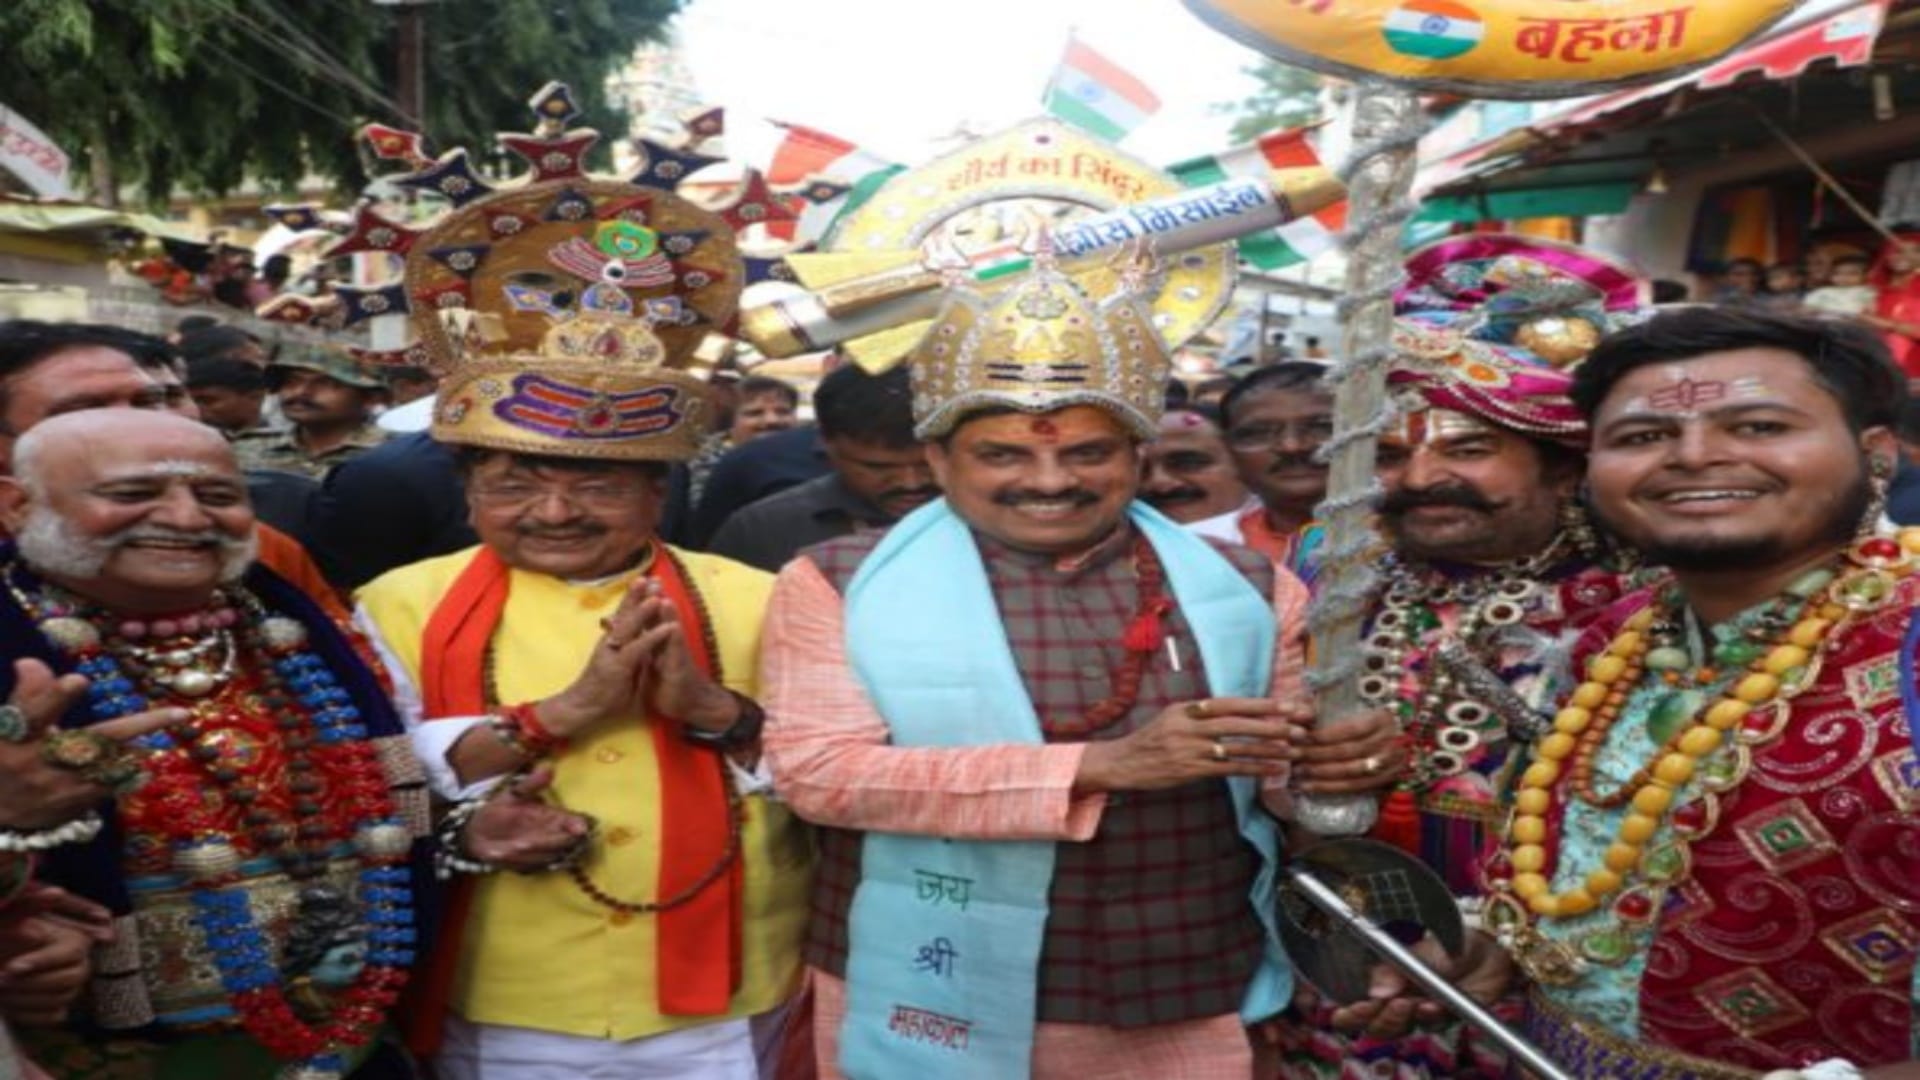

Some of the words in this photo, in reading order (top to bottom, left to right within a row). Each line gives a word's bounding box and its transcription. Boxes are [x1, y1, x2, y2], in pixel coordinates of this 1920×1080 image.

[1516, 6, 1694, 63] बहना
[1018, 156, 1060, 177] का
[913, 868, 975, 912] जय
[911, 936, 959, 978] श्री
